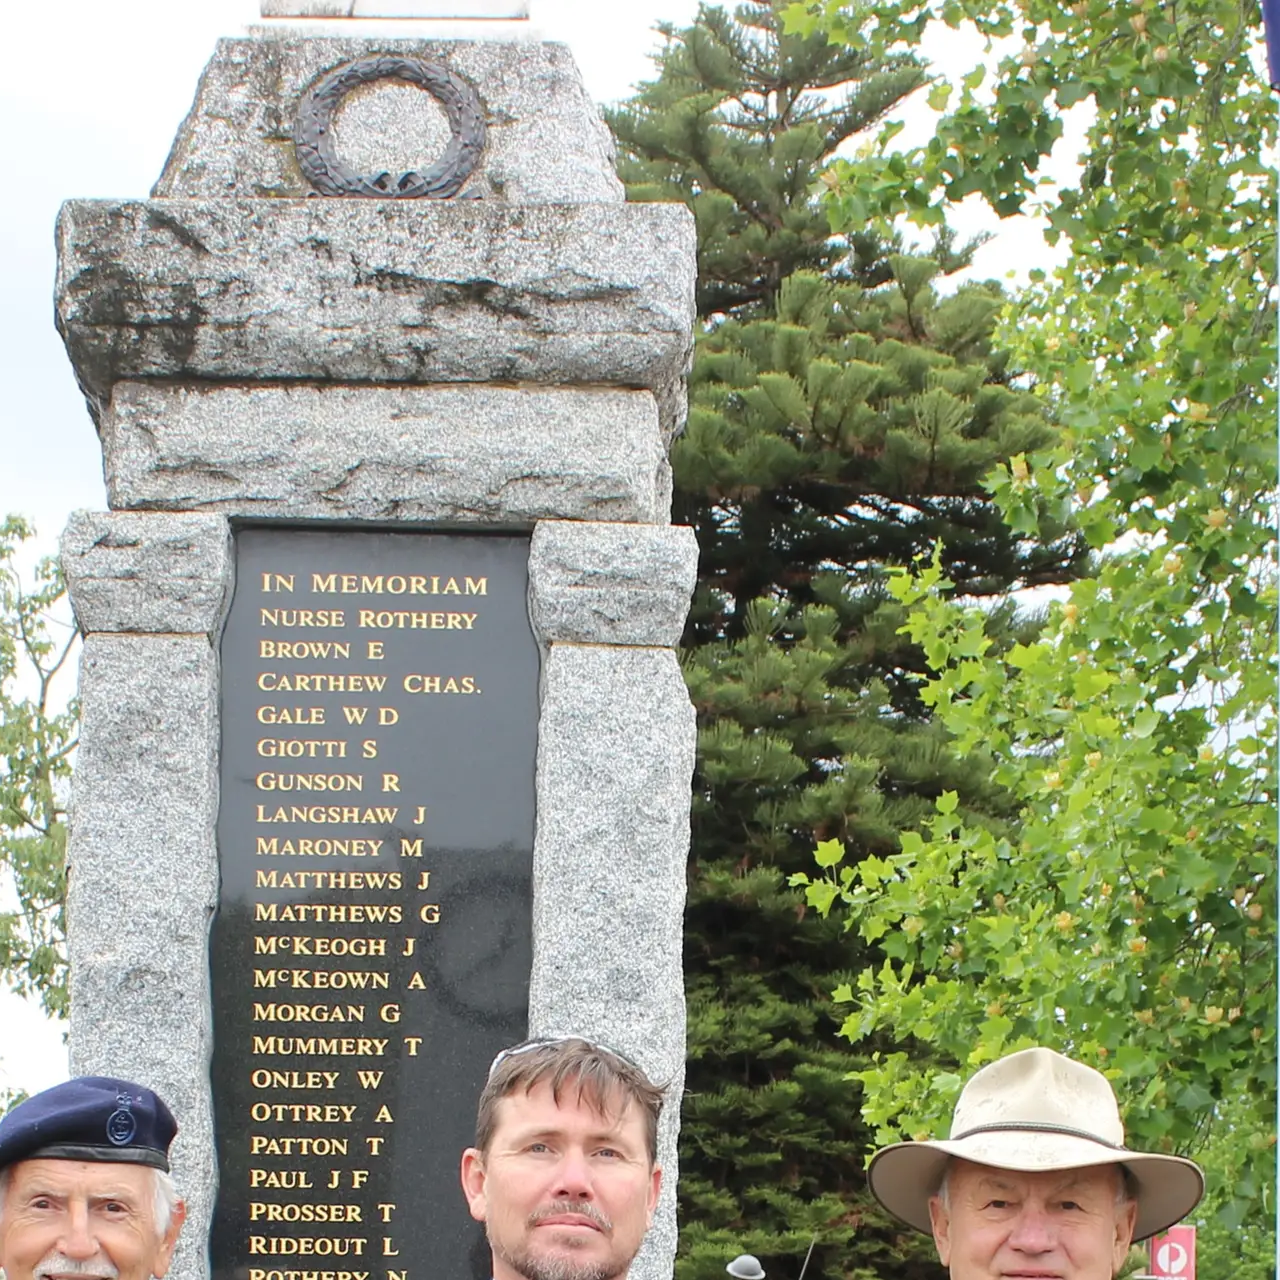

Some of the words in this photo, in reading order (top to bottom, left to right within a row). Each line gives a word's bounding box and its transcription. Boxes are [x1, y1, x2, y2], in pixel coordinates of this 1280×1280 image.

[261, 572, 295, 593] IN
[311, 573, 488, 595] MEMORIAM
[259, 608, 345, 627] NURSE
[358, 609, 478, 629] ROTHERY
[259, 639, 351, 659] BROWN
[367, 640, 385, 659] E
[256, 672, 388, 692] CARTHEW
[403, 674, 482, 694] CHAS.
[256, 705, 325, 725] GALE
[342, 705, 367, 725] W
[378, 707, 399, 725] D
[256, 738, 348, 758] GIOTTI
[362, 739, 378, 759] S
[256, 771, 363, 792] GUNSON
[381, 773, 401, 792] R
[256, 804, 398, 824] LANGSHAW
[413, 806, 426, 825] J
[255, 836, 384, 857] MARONEY
[400, 838, 423, 857] M
[255, 869, 402, 889] MATTHEWS
[417, 871, 431, 890] J
[255, 903, 402, 923] MATTHEWS
[420, 904, 441, 924] G
[402, 938, 416, 957] J
[407, 971, 427, 990] A
[253, 1003, 365, 1022] MORGAN
[380, 1004, 401, 1023] G
[253, 1036, 389, 1056] MUMMERY
[404, 1037, 423, 1056] T
[252, 1069, 340, 1089] ONLEY
[357, 1070, 384, 1089] W
[251, 1102, 357, 1123] OTTREY
[374, 1104, 394, 1123] A
[250, 1136, 348, 1156] PATTON
[366, 1137, 385, 1156] T
[250, 1169, 313, 1189] PAUL
[327, 1170, 341, 1189] J
[352, 1170, 369, 1189] F
[250, 1202, 363, 1222] PROSSER
[377, 1203, 396, 1222] T
[249, 1236, 368, 1256] RIDEOUT
[383, 1237, 399, 1256] L
